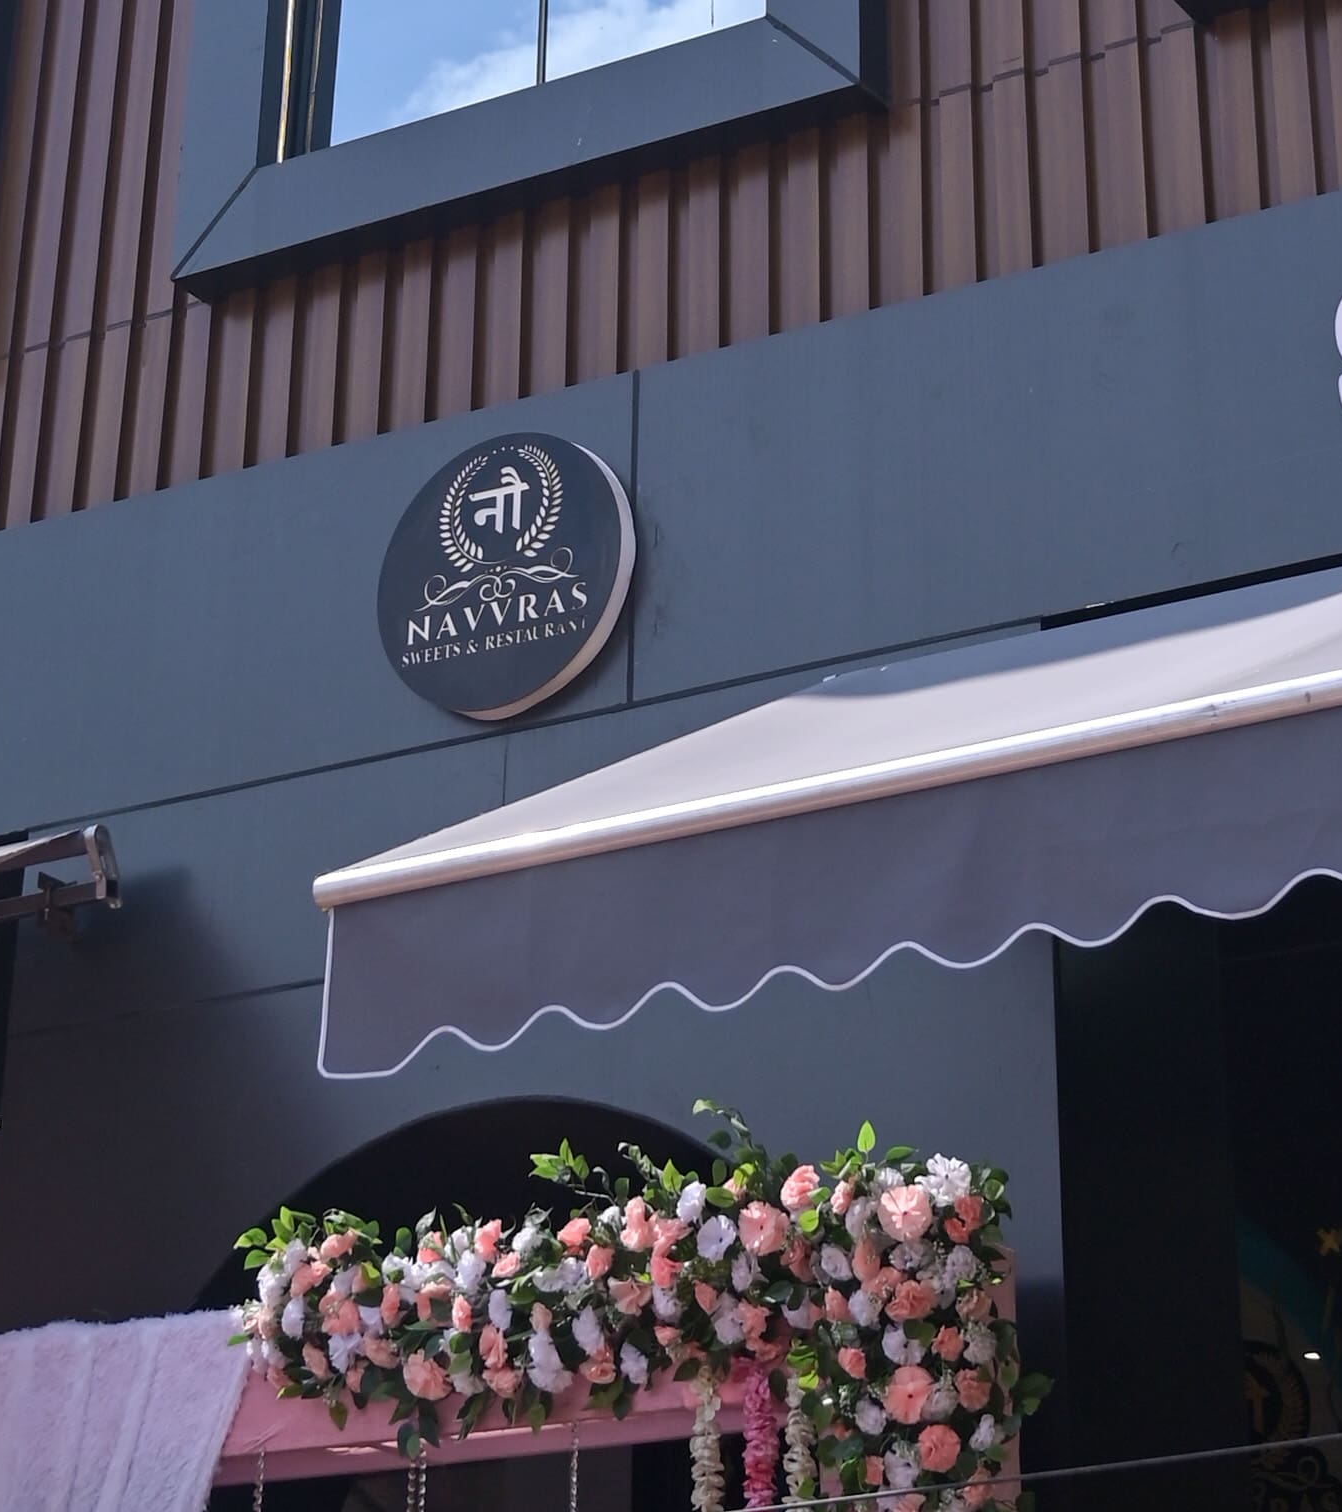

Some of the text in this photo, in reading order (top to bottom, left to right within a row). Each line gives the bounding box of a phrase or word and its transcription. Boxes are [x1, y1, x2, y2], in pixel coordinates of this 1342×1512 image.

[401, 614, 588, 668] SWEETS & RESTAURANT
[406, 581, 589, 646] NAVVRAS
